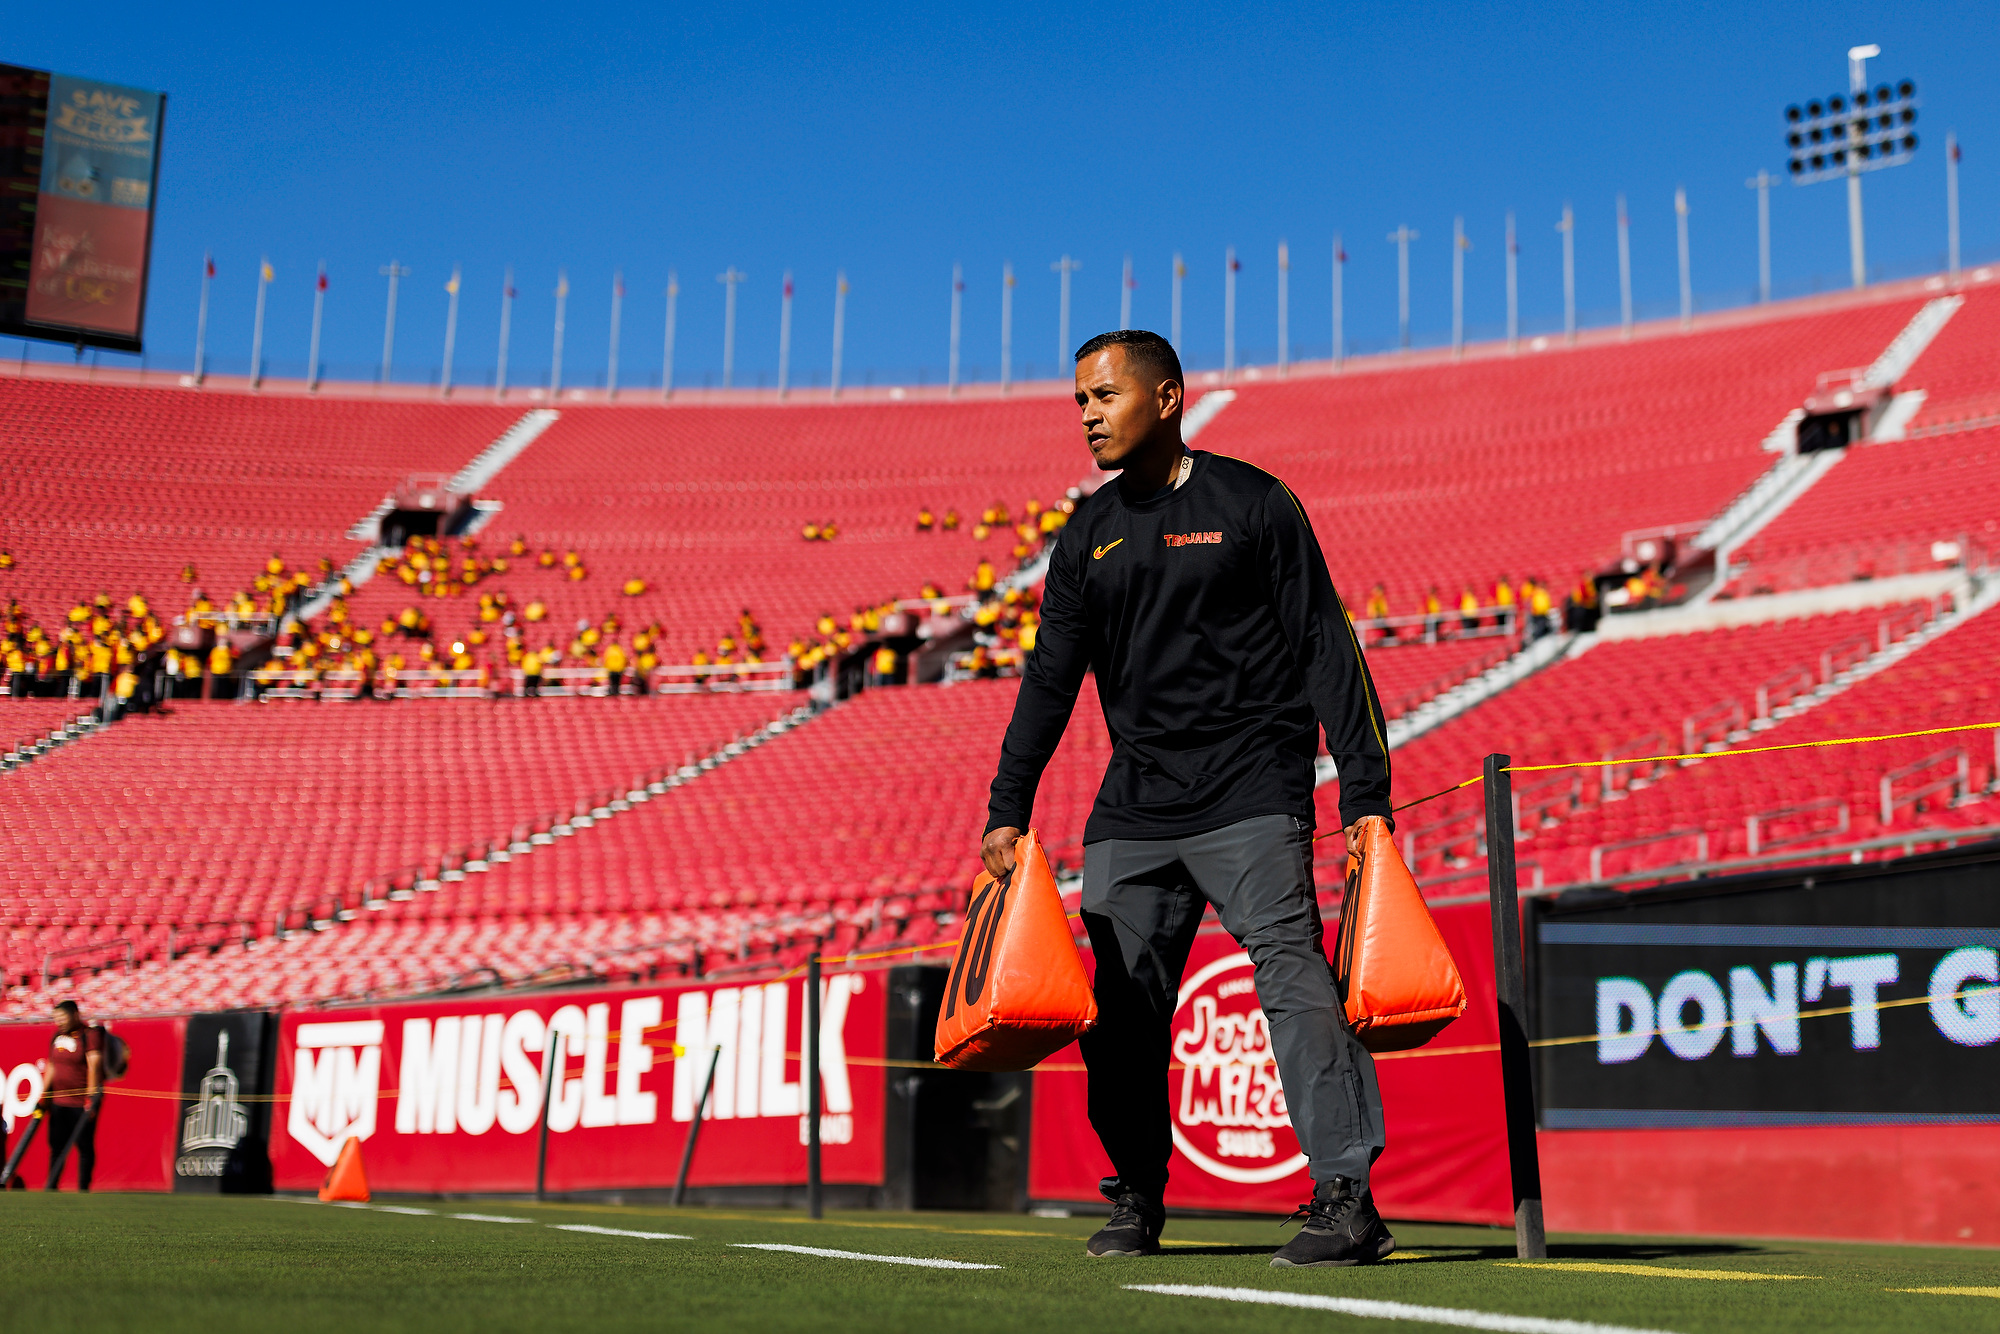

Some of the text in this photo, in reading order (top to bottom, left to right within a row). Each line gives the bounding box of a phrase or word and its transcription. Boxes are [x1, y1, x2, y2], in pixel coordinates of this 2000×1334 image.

[72, 89, 141, 117] SAVE
[1163, 531, 1223, 547] TROJANS
[946, 861, 1017, 1022] 10
[394, 974, 854, 1137] MUSCLE MILK
[1595, 953, 1900, 1065] DON'T
